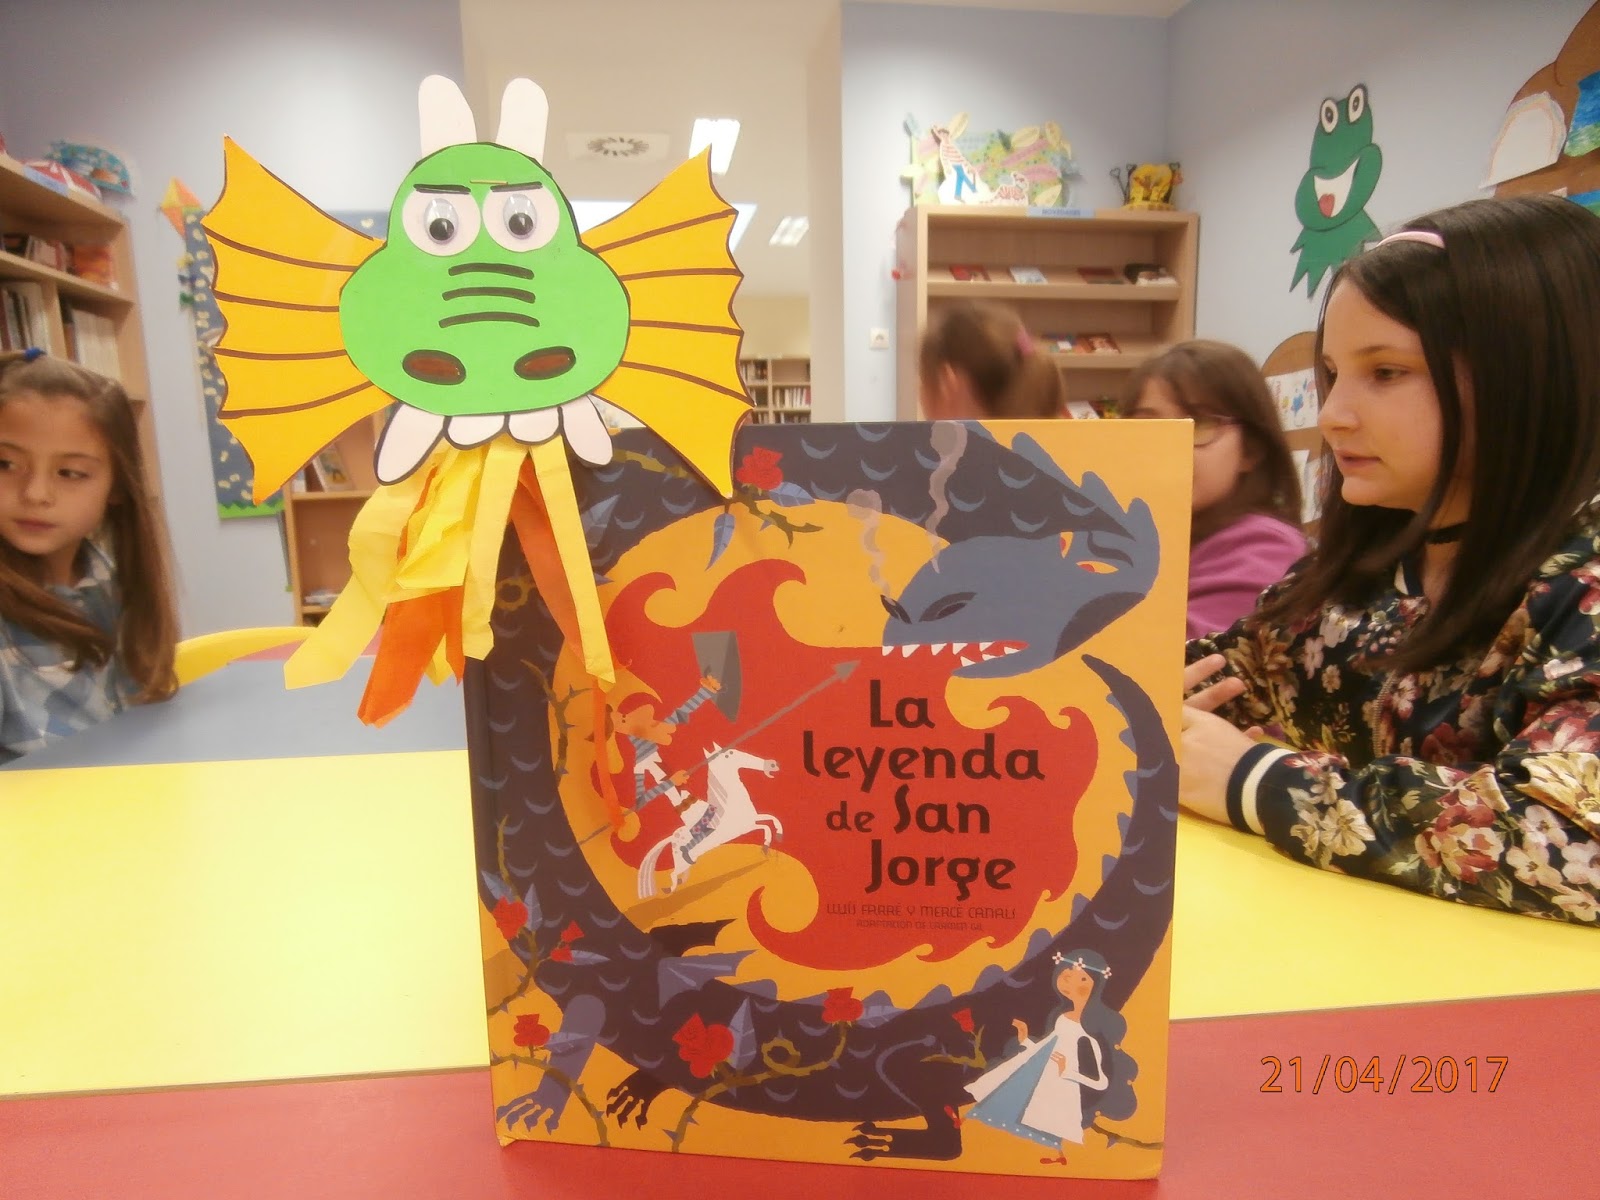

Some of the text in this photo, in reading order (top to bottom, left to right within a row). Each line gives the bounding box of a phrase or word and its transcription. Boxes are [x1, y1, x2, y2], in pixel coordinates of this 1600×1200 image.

[870, 679, 936, 729] La
[803, 730, 1046, 793] leyenda
[825, 783, 991, 834] de San
[864, 839, 1016, 901] Jorge
[906, 905, 916, 917] Y
[968, 906, 1016, 920] CANALS
